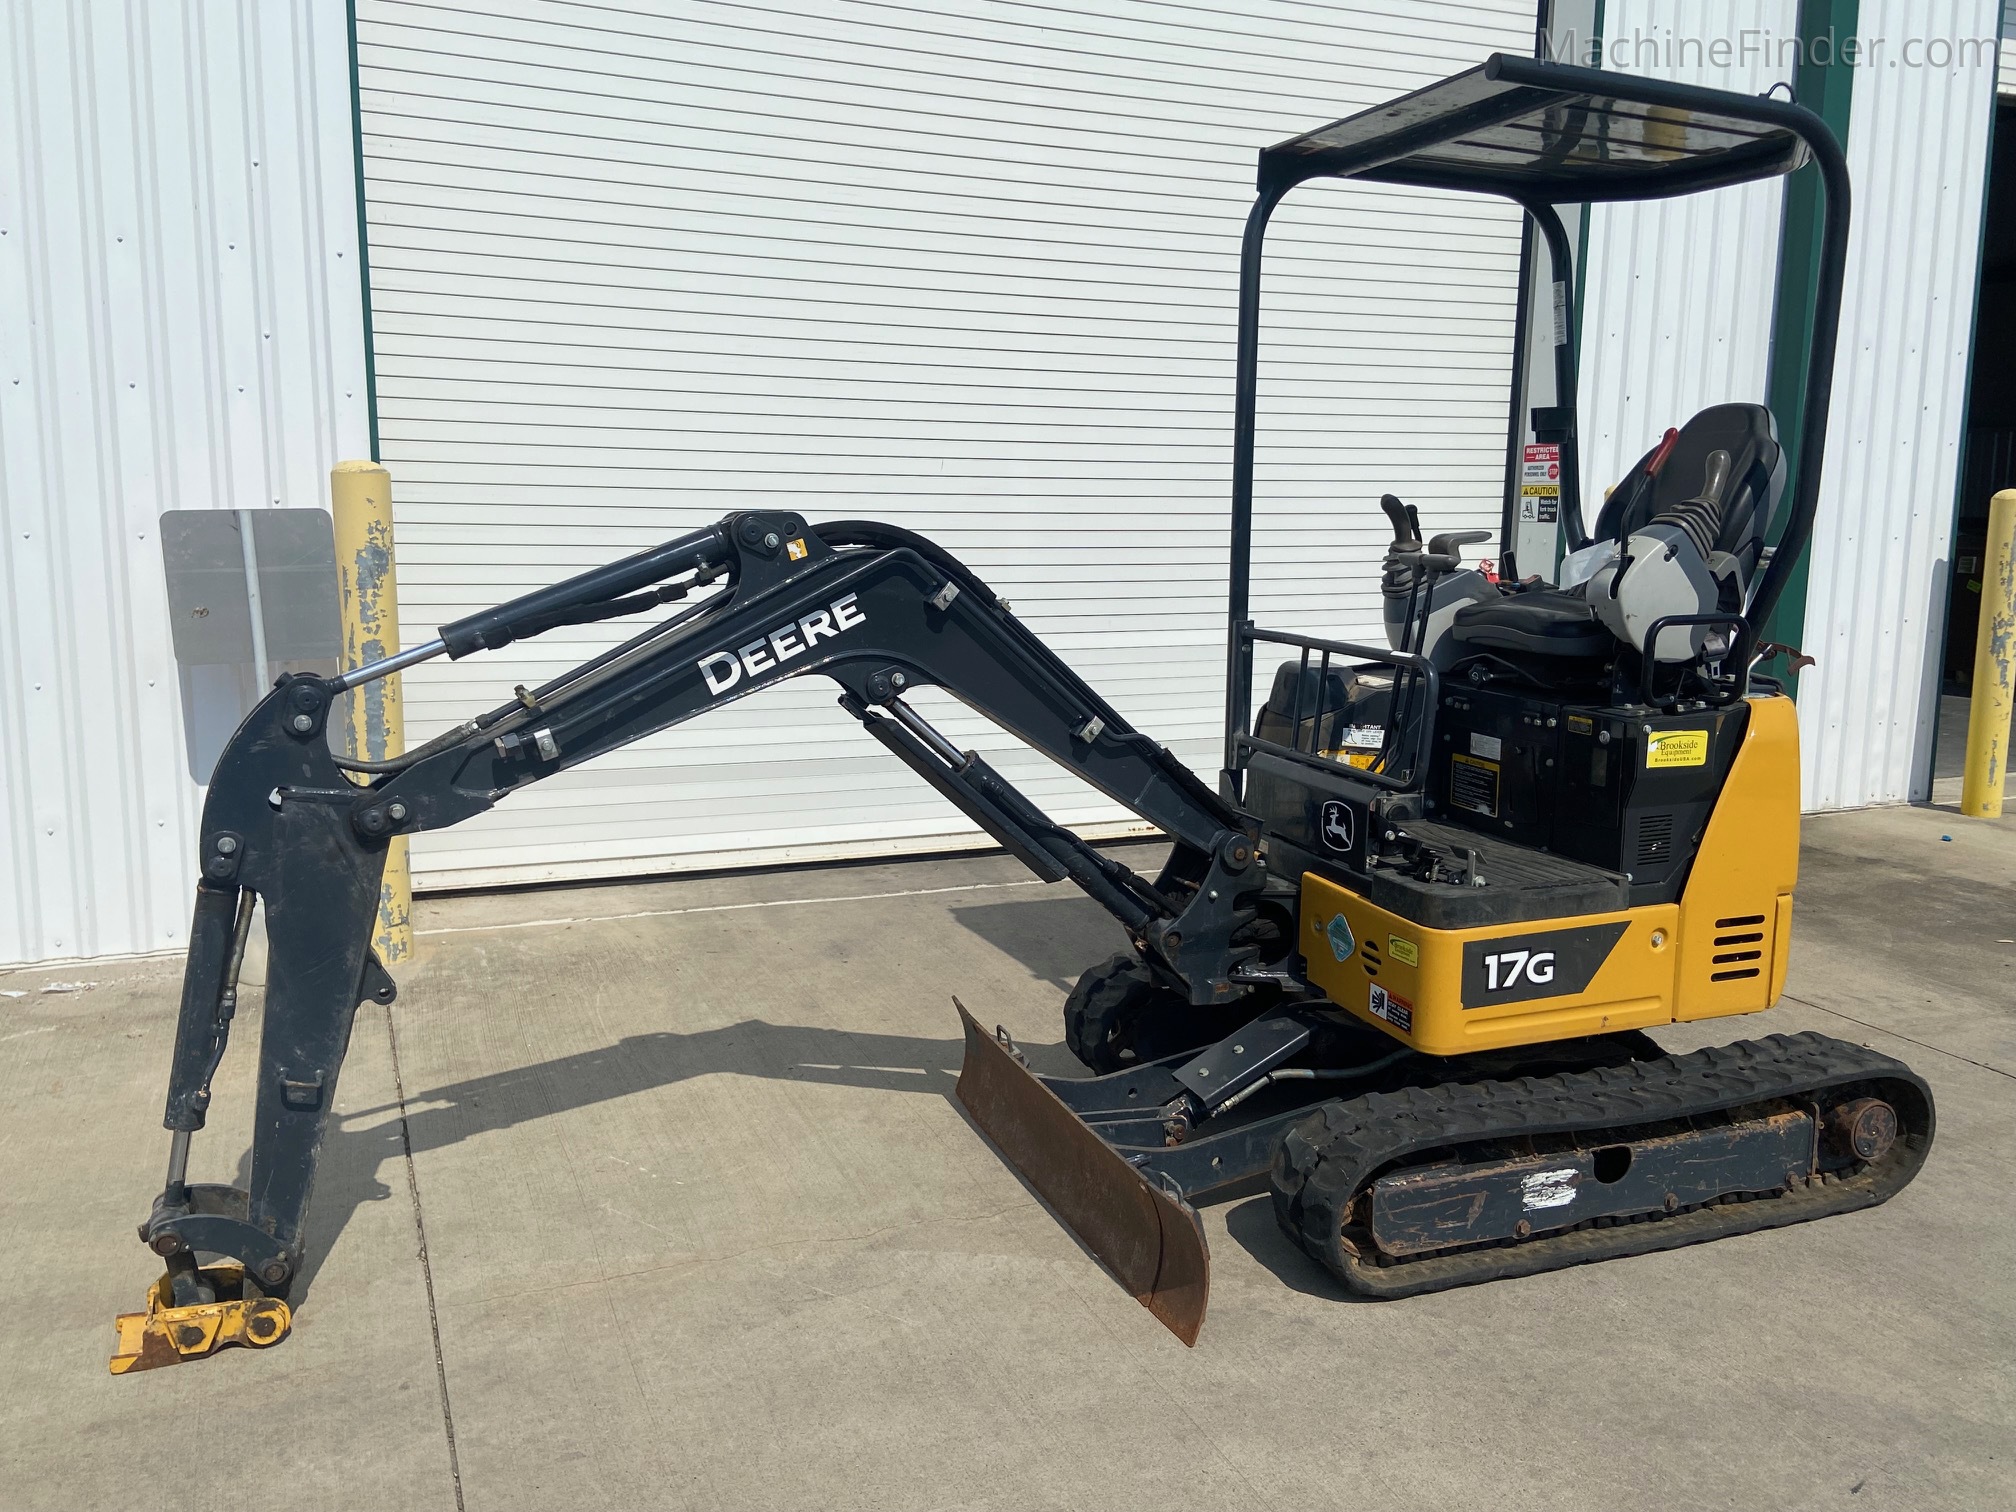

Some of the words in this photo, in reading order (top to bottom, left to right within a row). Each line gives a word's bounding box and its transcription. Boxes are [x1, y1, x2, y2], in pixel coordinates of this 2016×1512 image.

[1529, 487, 1557, 495] CAUTION
[697, 592, 866, 696] DEERE
[1660, 740, 1698, 750] Brookside
[1484, 951, 1555, 990] 17G
